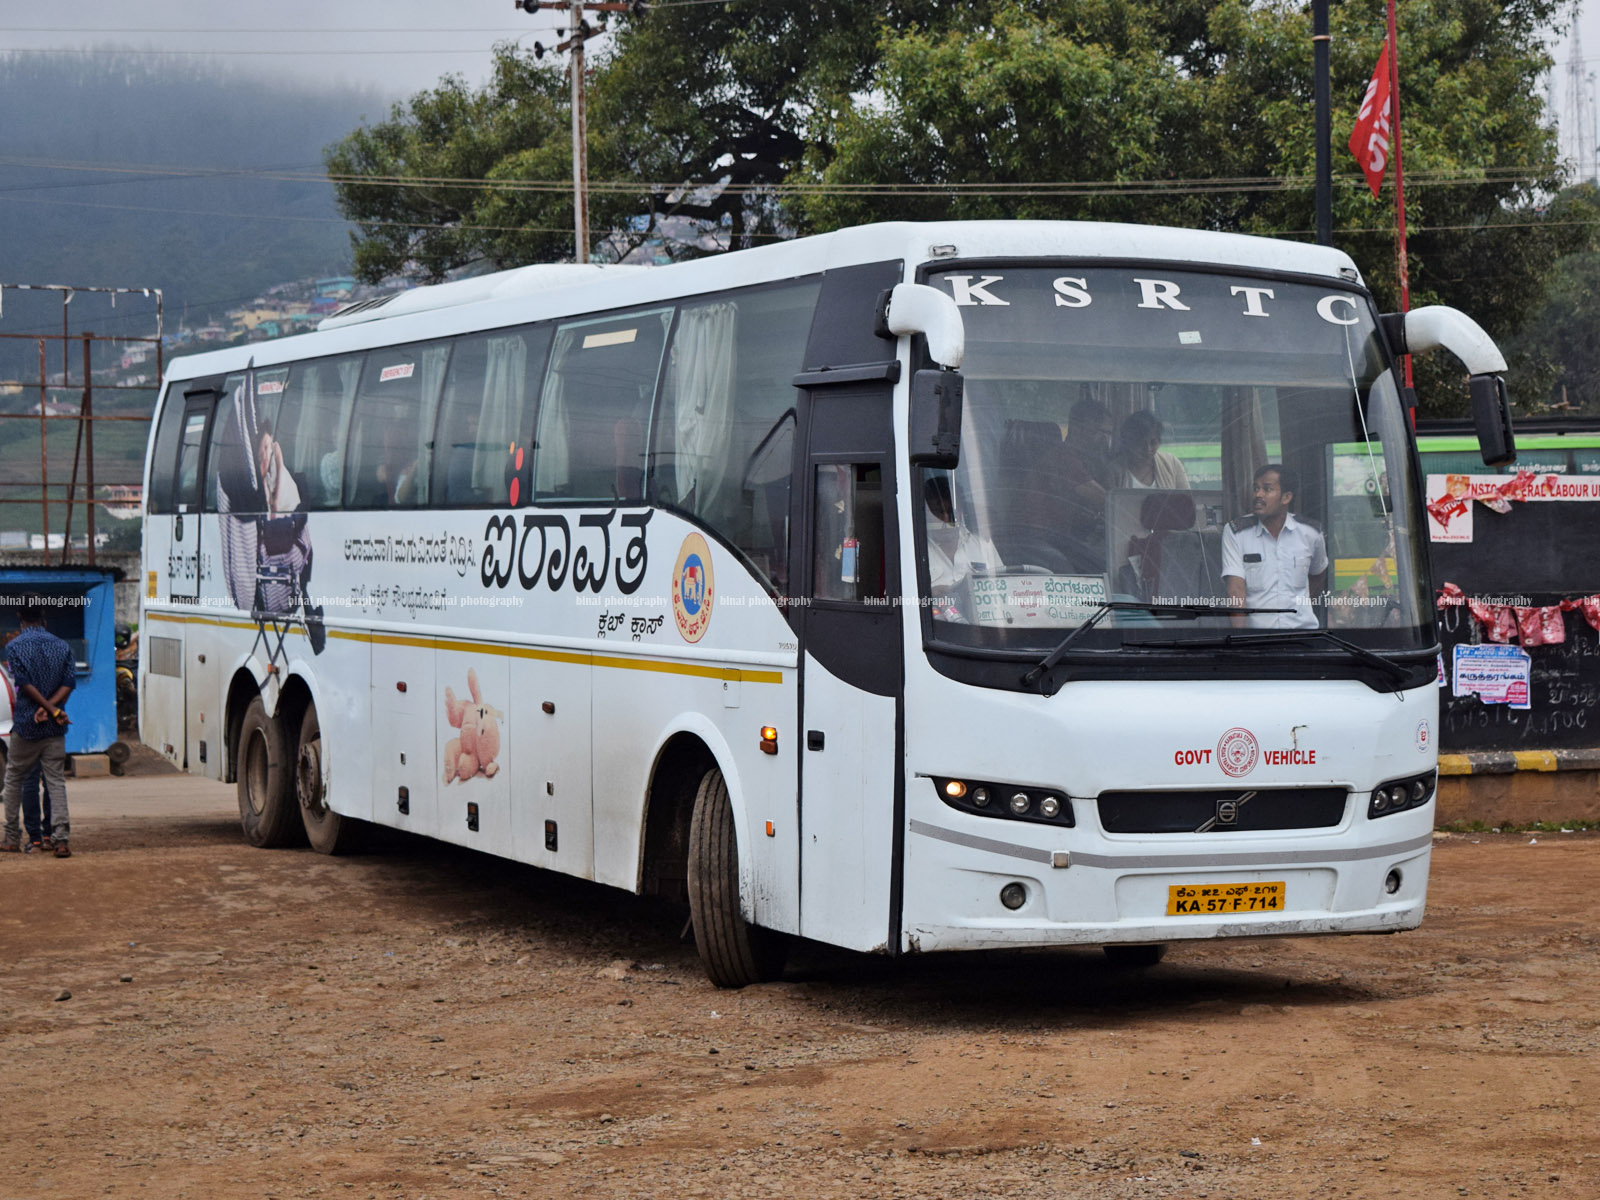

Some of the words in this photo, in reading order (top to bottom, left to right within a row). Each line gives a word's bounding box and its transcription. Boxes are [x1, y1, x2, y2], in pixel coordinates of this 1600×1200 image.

[1550, 484, 1589, 497] LABOUR
[481, 508, 654, 594] ಐರಾವತ
[631, 614, 665, 642] ಕ್ಲಾಸ್
[1174, 749, 1212, 766] GOVT
[1263, 750, 1316, 765] VEHICLE
